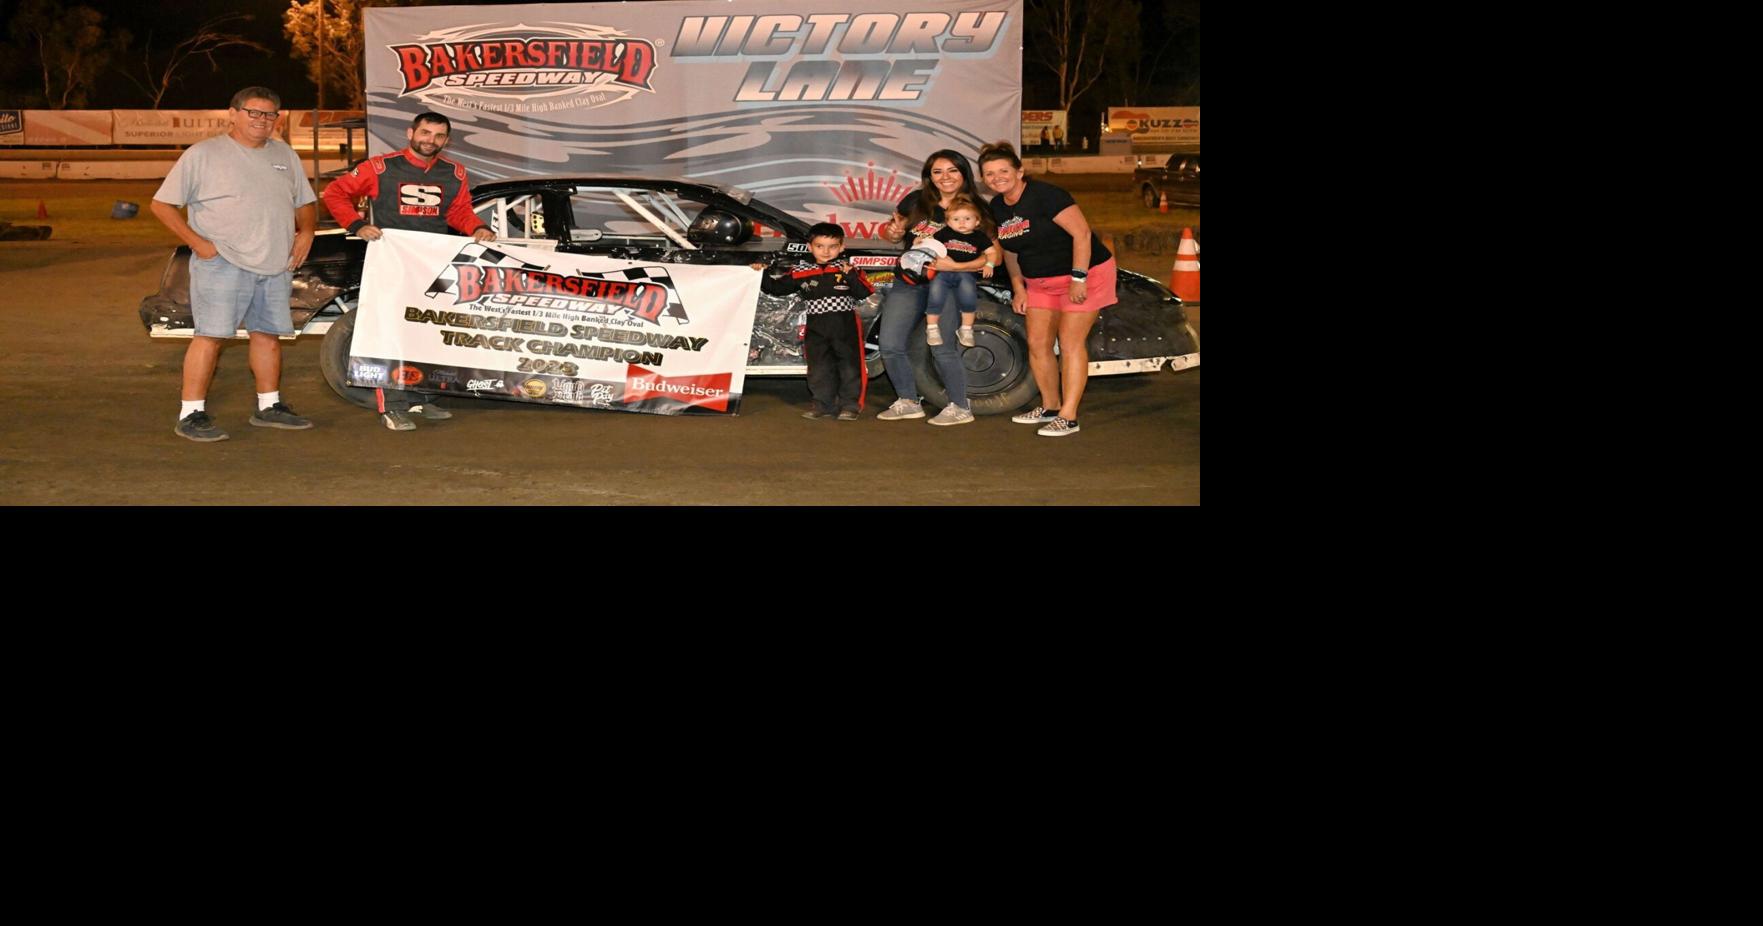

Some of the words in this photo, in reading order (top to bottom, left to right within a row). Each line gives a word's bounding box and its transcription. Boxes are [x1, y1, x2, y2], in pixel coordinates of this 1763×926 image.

[671, 11, 1007, 57] VICTORY
[396, 38, 654, 93] BAKERSFIELD
[445, 71, 604, 87] SPEEDWAY
[734, 58, 940, 102] LANE
[443, 95, 455, 105] The
[504, 104, 514, 113] 1/3
[515, 104, 530, 113] Mile
[532, 103, 548, 113] High
[550, 99, 575, 111] Banked
[575, 97, 591, 108] Clay
[591, 93, 606, 103] Oval
[401, 206, 438, 214] SIMPSON
[456, 264, 669, 324] BAKERSFIELD
[491, 294, 621, 315] SPEEDWAY
[469, 303, 482, 312] The
[506, 307, 531, 317] Fastest
[532, 309, 544, 318] 1/3
[545, 311, 561, 319] Mile
[563, 313, 580, 322] High
[581, 315, 608, 324] Banked
[610, 318, 626, 327] Clay
[627, 320, 644, 328] Oval
[404, 306, 568, 337] BAKERSFIELD
[570, 324, 709, 352] SPEEDWAY
[440, 330, 526, 353] TRACK
[526, 339, 664, 366] CHAMPION
[354, 371, 385, 380] LIGHT
[516, 356, 579, 377] 2023
[631, 377, 724, 398] Budweiser
